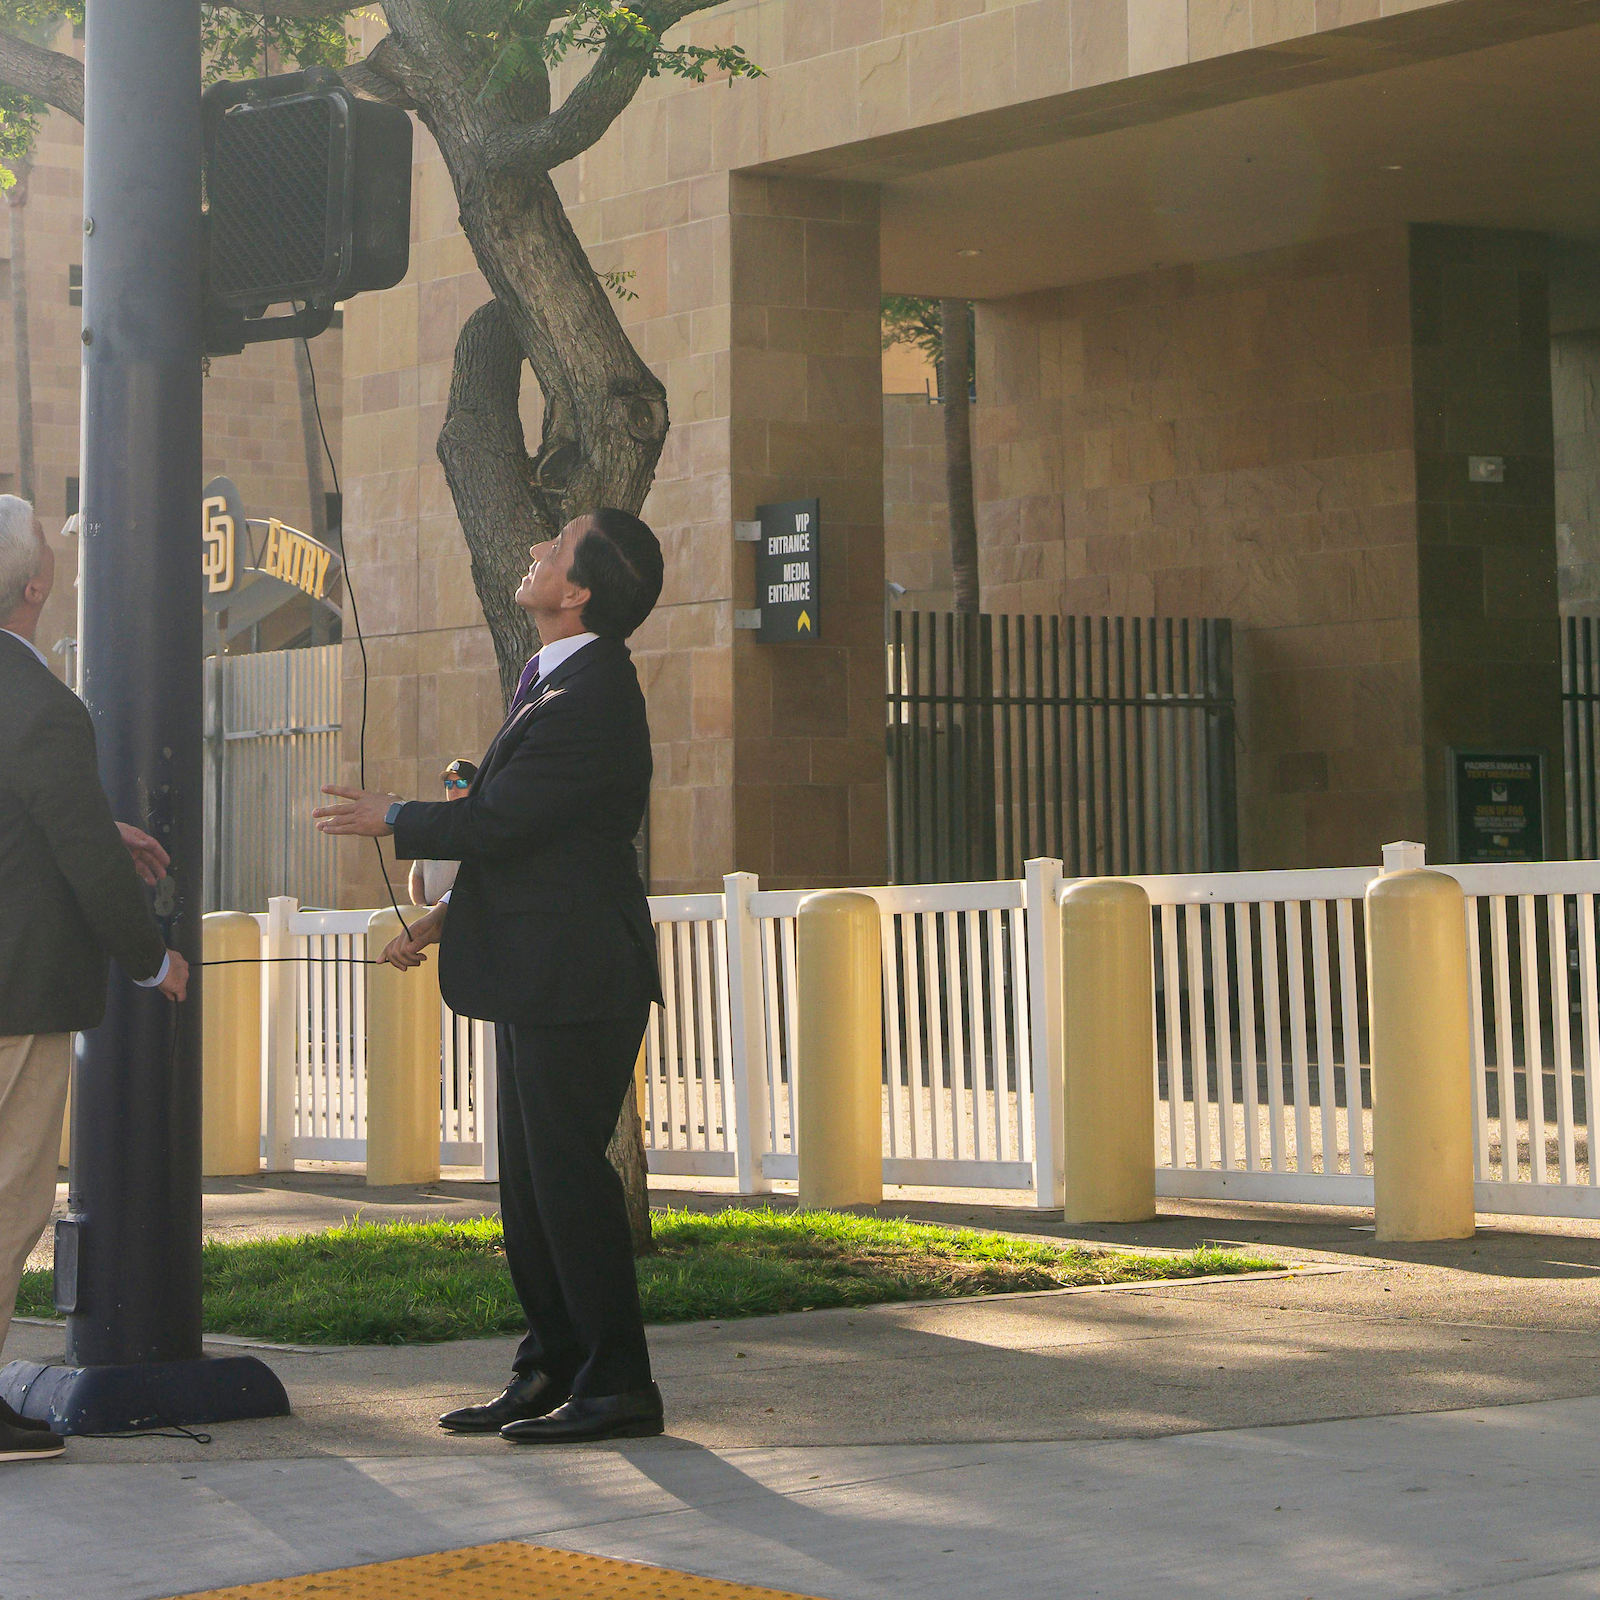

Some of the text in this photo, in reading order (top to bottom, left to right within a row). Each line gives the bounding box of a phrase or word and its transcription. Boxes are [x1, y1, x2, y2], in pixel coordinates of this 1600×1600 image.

[795, 513, 810, 532] VIP
[768, 533, 810, 555] ENTRANCE
[266, 517, 331, 601] ENTRY
[783, 562, 810, 582] MEDIA
[768, 582, 810, 603] ENTRANCE
